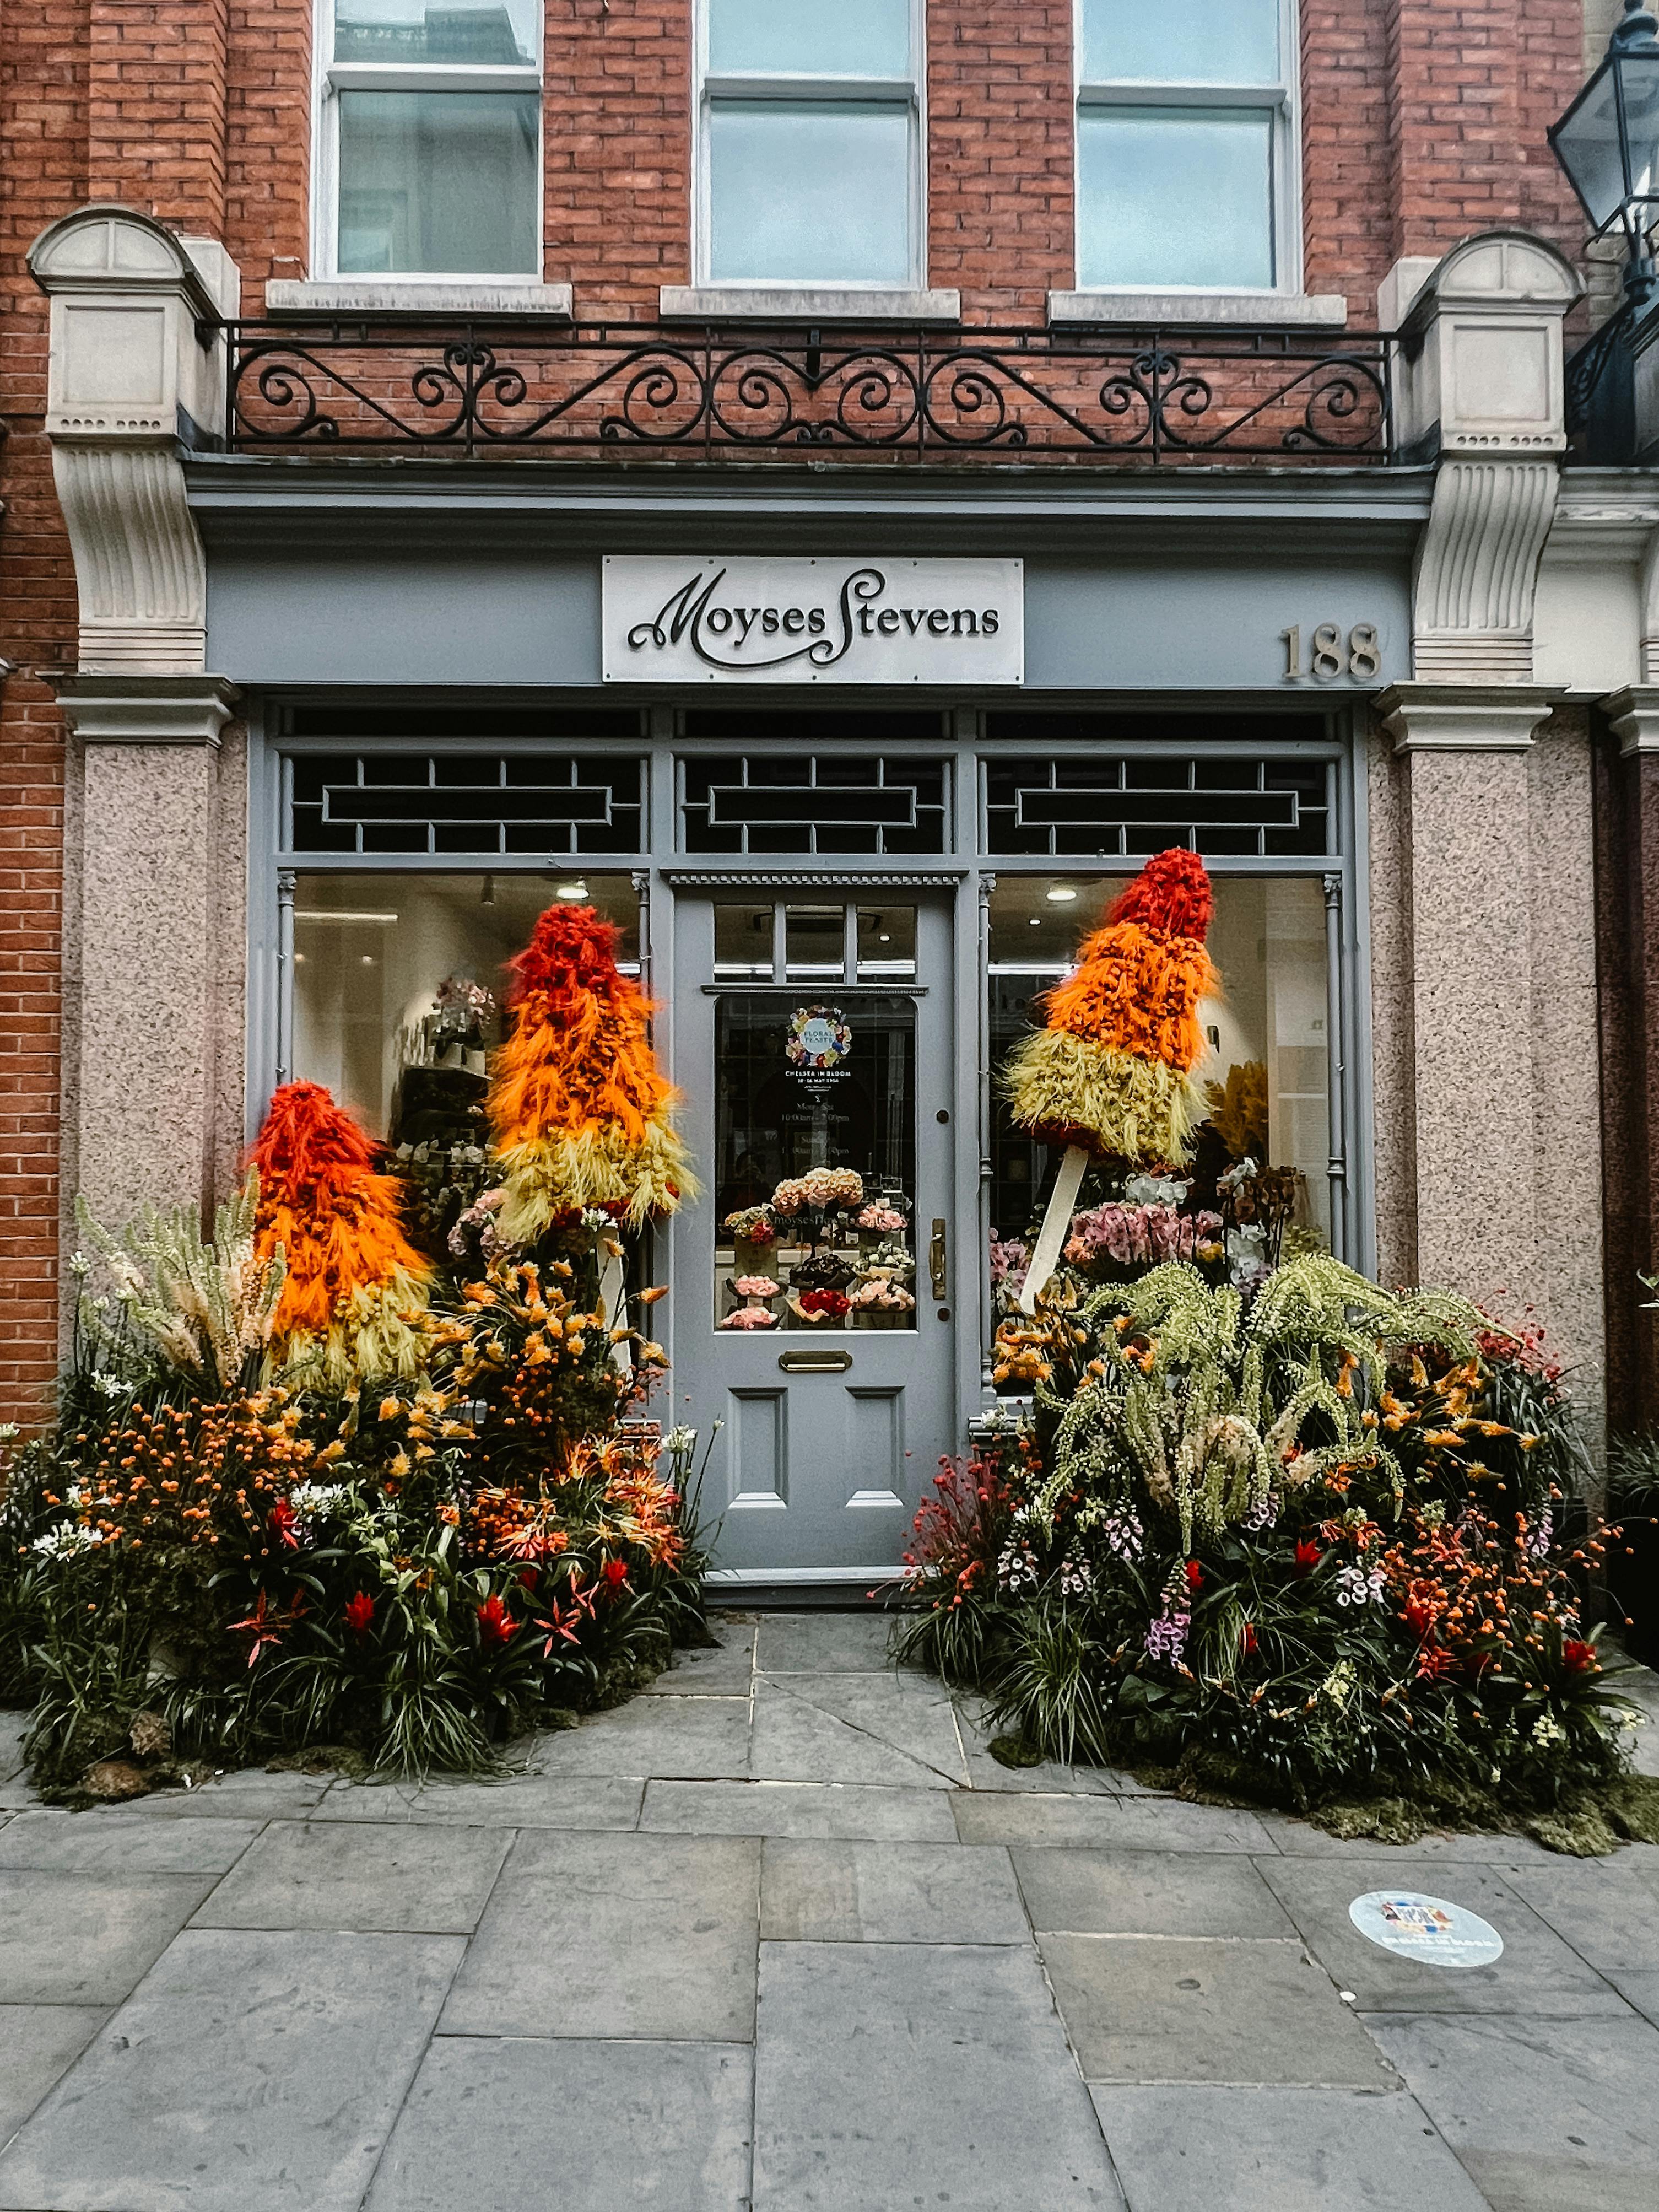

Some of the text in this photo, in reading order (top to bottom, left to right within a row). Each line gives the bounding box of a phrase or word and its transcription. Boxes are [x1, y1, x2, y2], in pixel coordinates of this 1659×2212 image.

[628, 568, 999, 669] Moyses Stevens
[1281, 623, 1381, 678] 188
